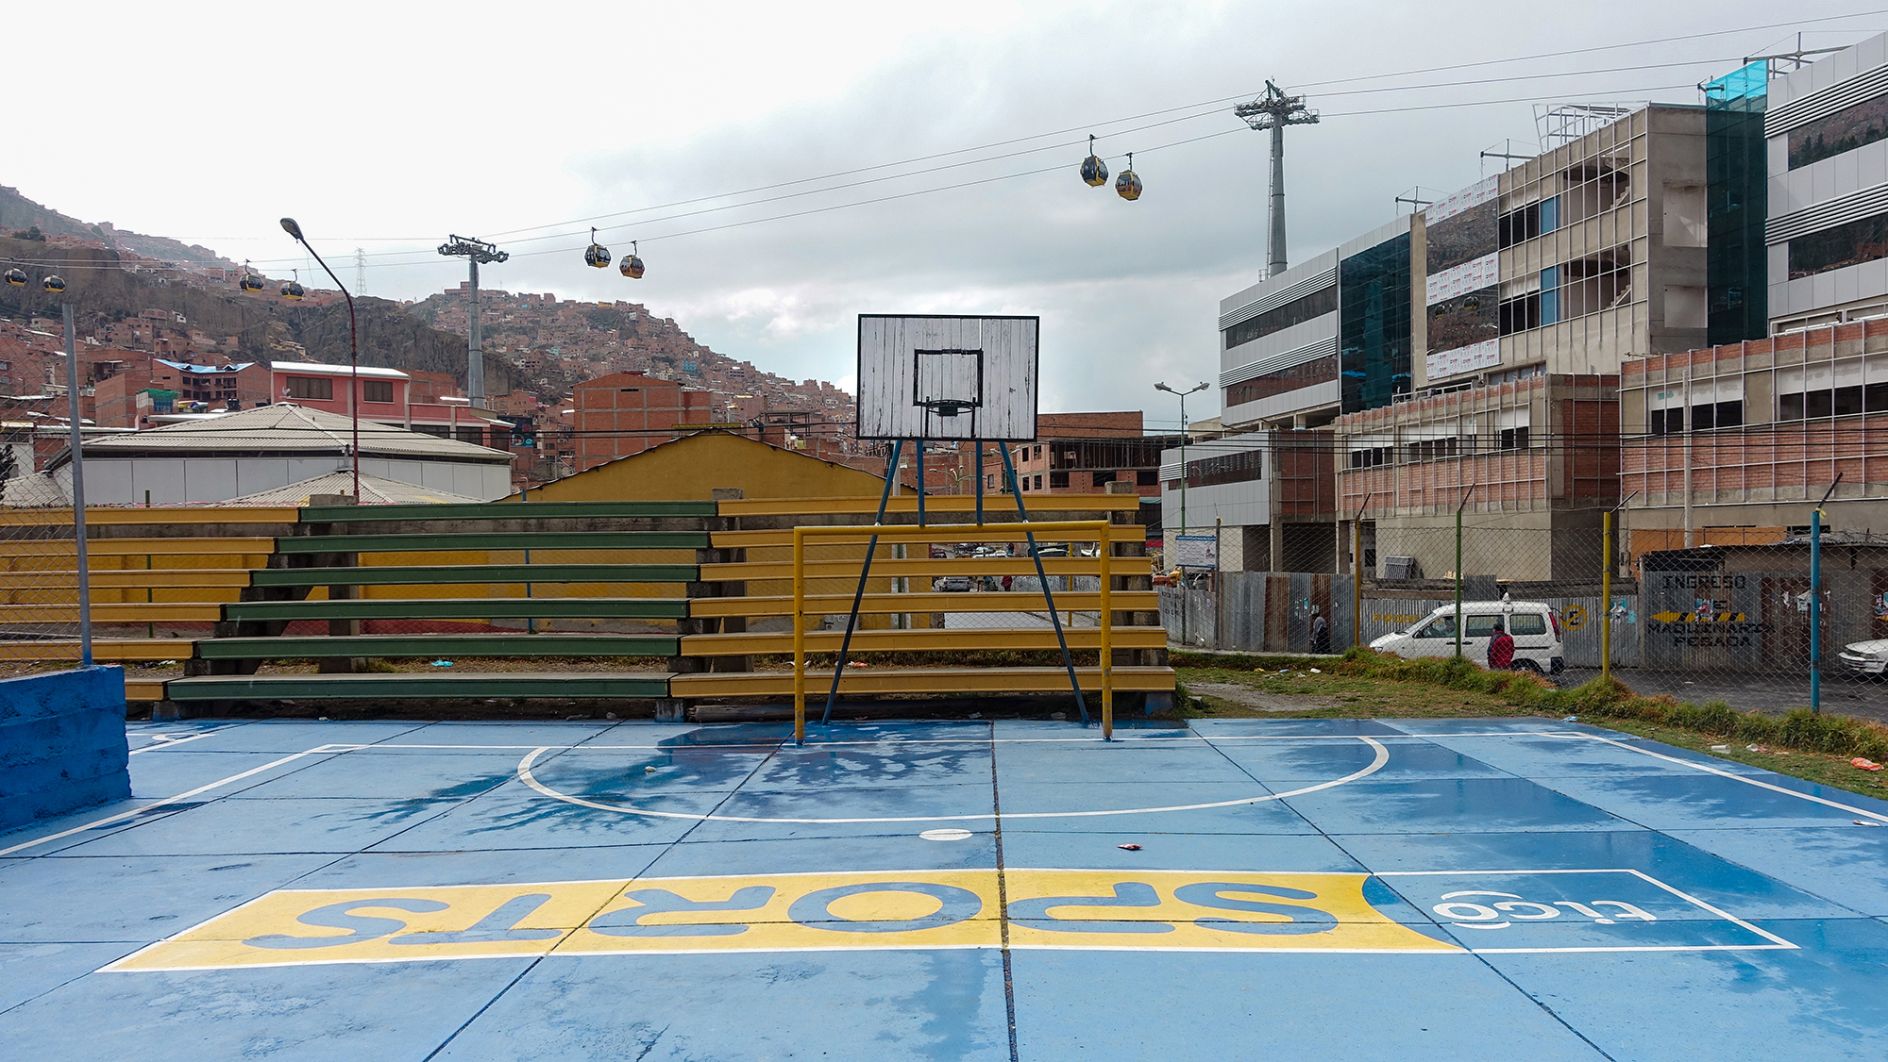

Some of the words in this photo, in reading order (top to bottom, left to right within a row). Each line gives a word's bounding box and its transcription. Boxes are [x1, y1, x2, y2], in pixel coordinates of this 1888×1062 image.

[1662, 575, 1747, 590] INGRESO
[1648, 623, 1777, 634] MAQUINARIA
[1674, 636, 1753, 647] PESADA
[242, 881, 1339, 949] SPORTS
